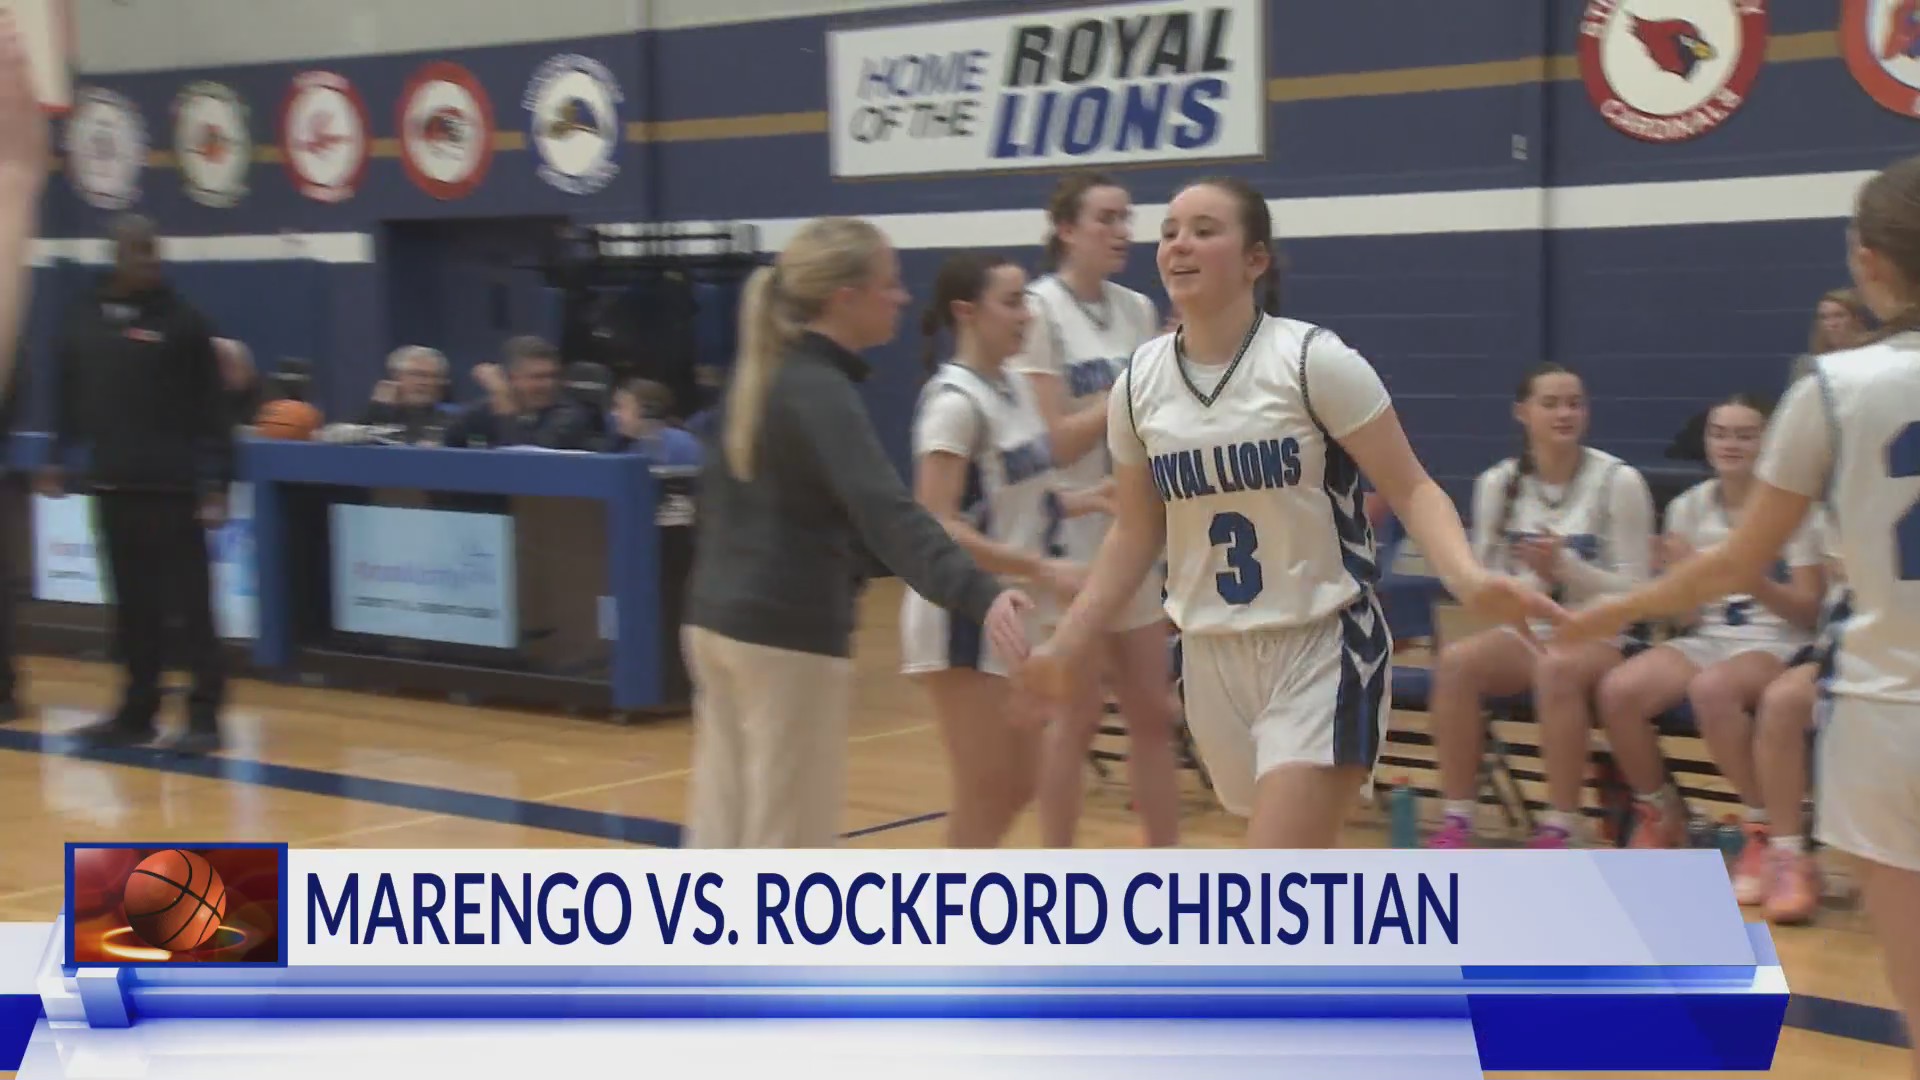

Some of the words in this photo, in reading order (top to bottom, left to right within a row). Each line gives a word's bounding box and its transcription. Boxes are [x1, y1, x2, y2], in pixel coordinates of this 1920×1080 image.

[858, 49, 989, 101] HOME
[1004, 7, 1234, 87] ROYAL
[850, 103, 904, 144] OF
[907, 98, 981, 139] THE
[990, 78, 1229, 159] LIONS
[1150, 449, 1216, 502] OYAL
[1214, 437, 1302, 493] LIONS
[1209, 511, 1264, 605] 3
